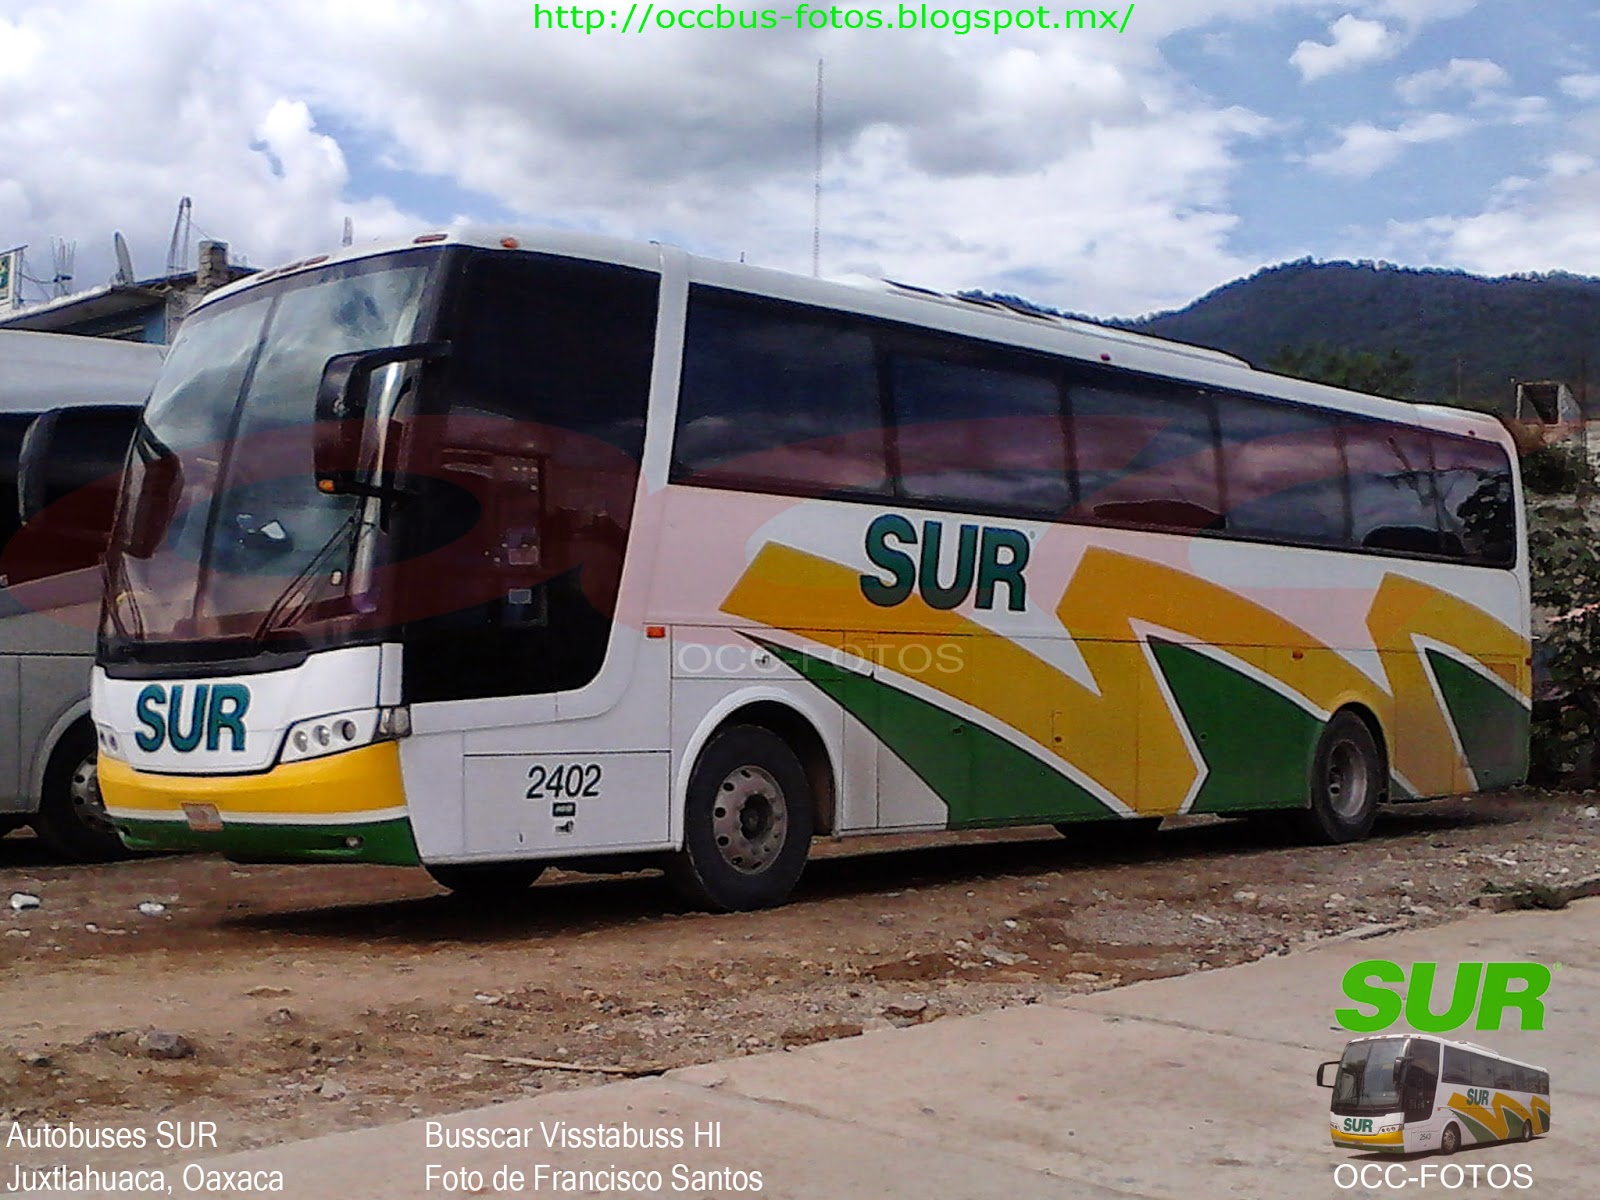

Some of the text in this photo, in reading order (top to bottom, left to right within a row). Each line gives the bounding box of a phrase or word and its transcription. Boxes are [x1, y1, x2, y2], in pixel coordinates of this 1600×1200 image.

[859, 513, 1030, 612] SUR
[135, 684, 250, 753] SUR
[526, 764, 602, 799] 2402
